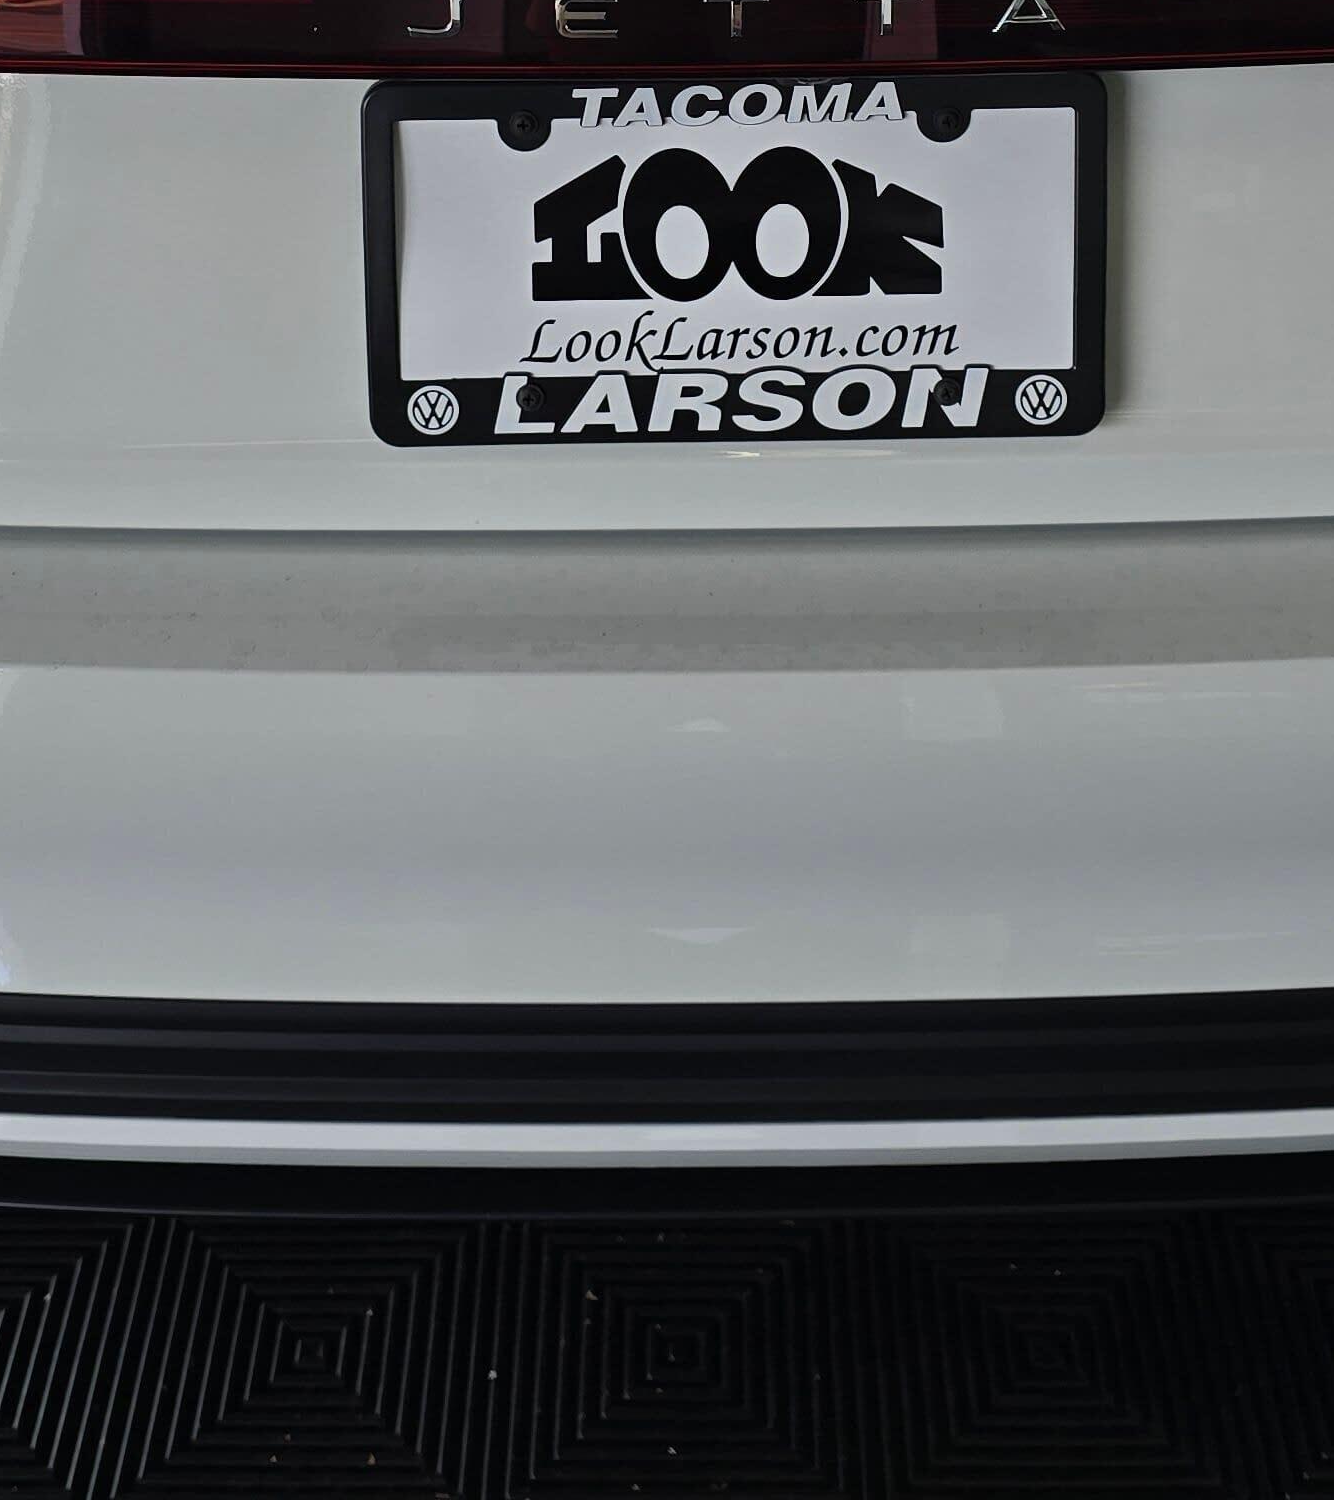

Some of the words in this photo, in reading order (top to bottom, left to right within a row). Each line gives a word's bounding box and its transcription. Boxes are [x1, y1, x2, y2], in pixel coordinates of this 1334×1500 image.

[571, 81, 905, 128] TACOMA
[532, 146, 945, 302] LOOK
[519, 310, 961, 372] LookLarson.com
[493, 366, 989, 435] LARSON
